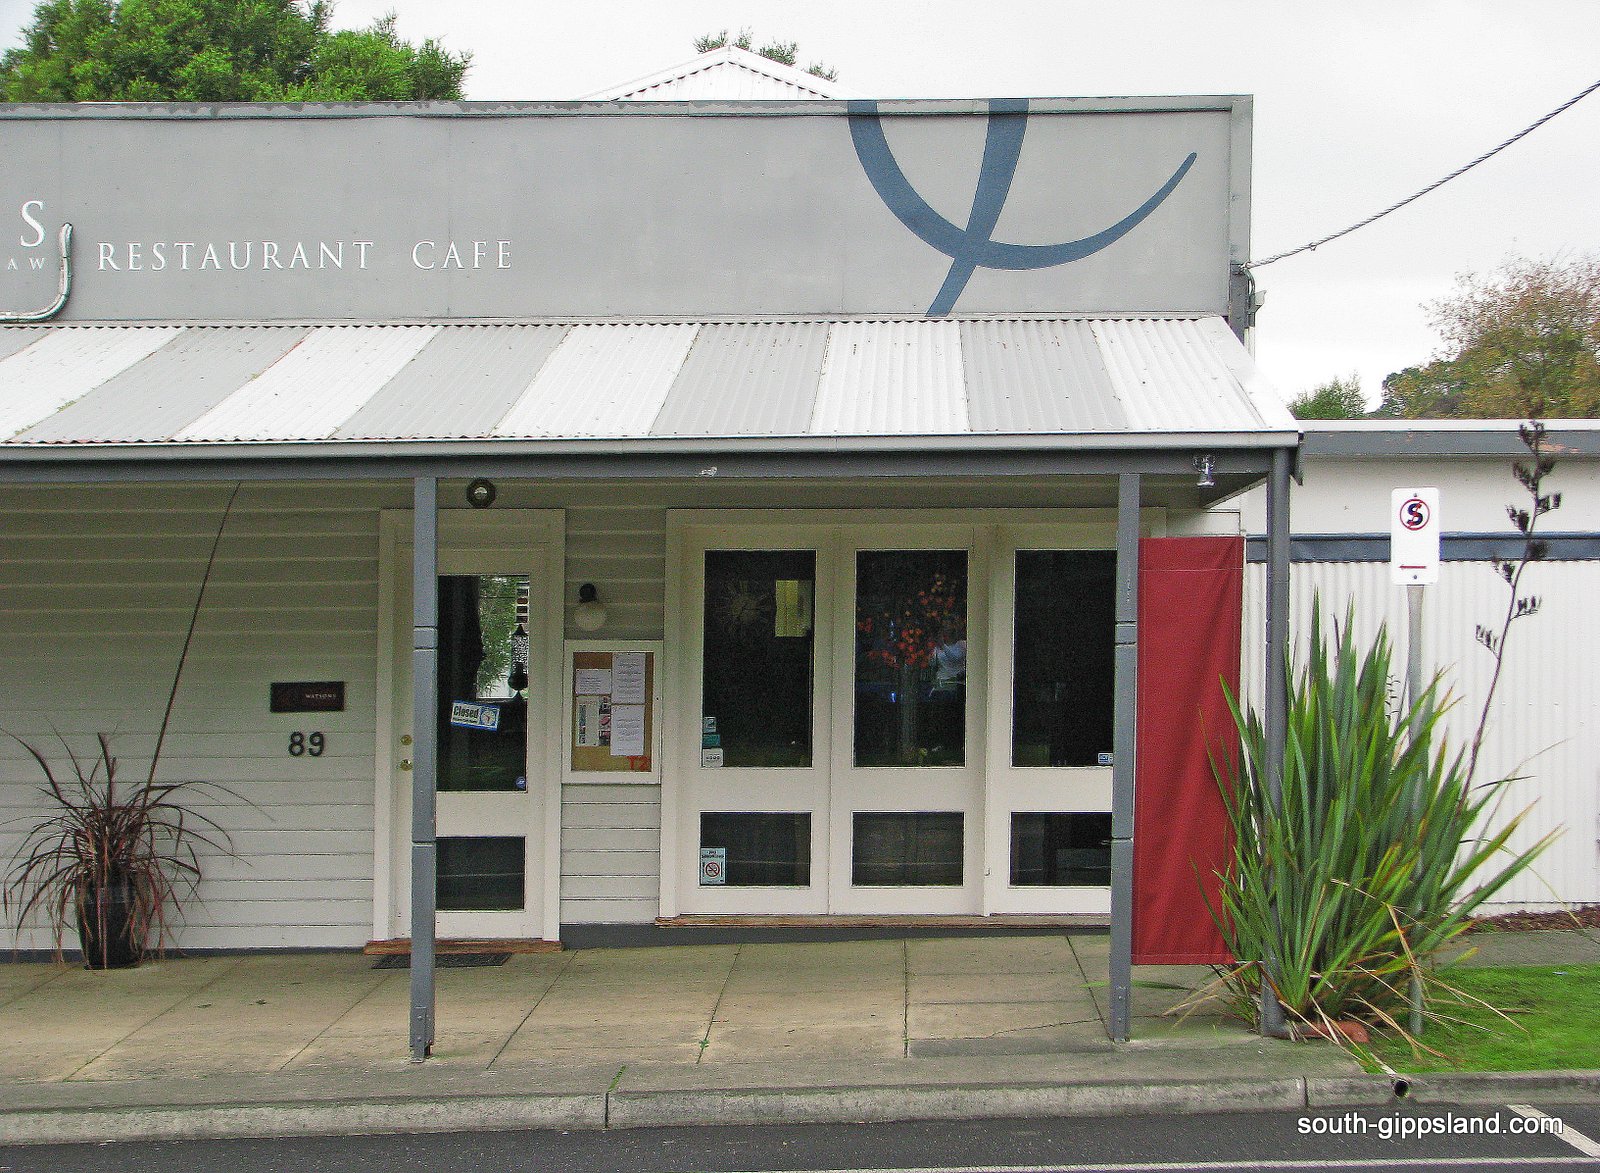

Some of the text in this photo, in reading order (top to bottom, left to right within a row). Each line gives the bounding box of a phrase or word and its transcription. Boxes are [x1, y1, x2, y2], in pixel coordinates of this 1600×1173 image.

[97, 240, 513, 271] RESTAURANT CAFE
[453, 705, 479, 719] Closed
[288, 731, 325, 757] 89
